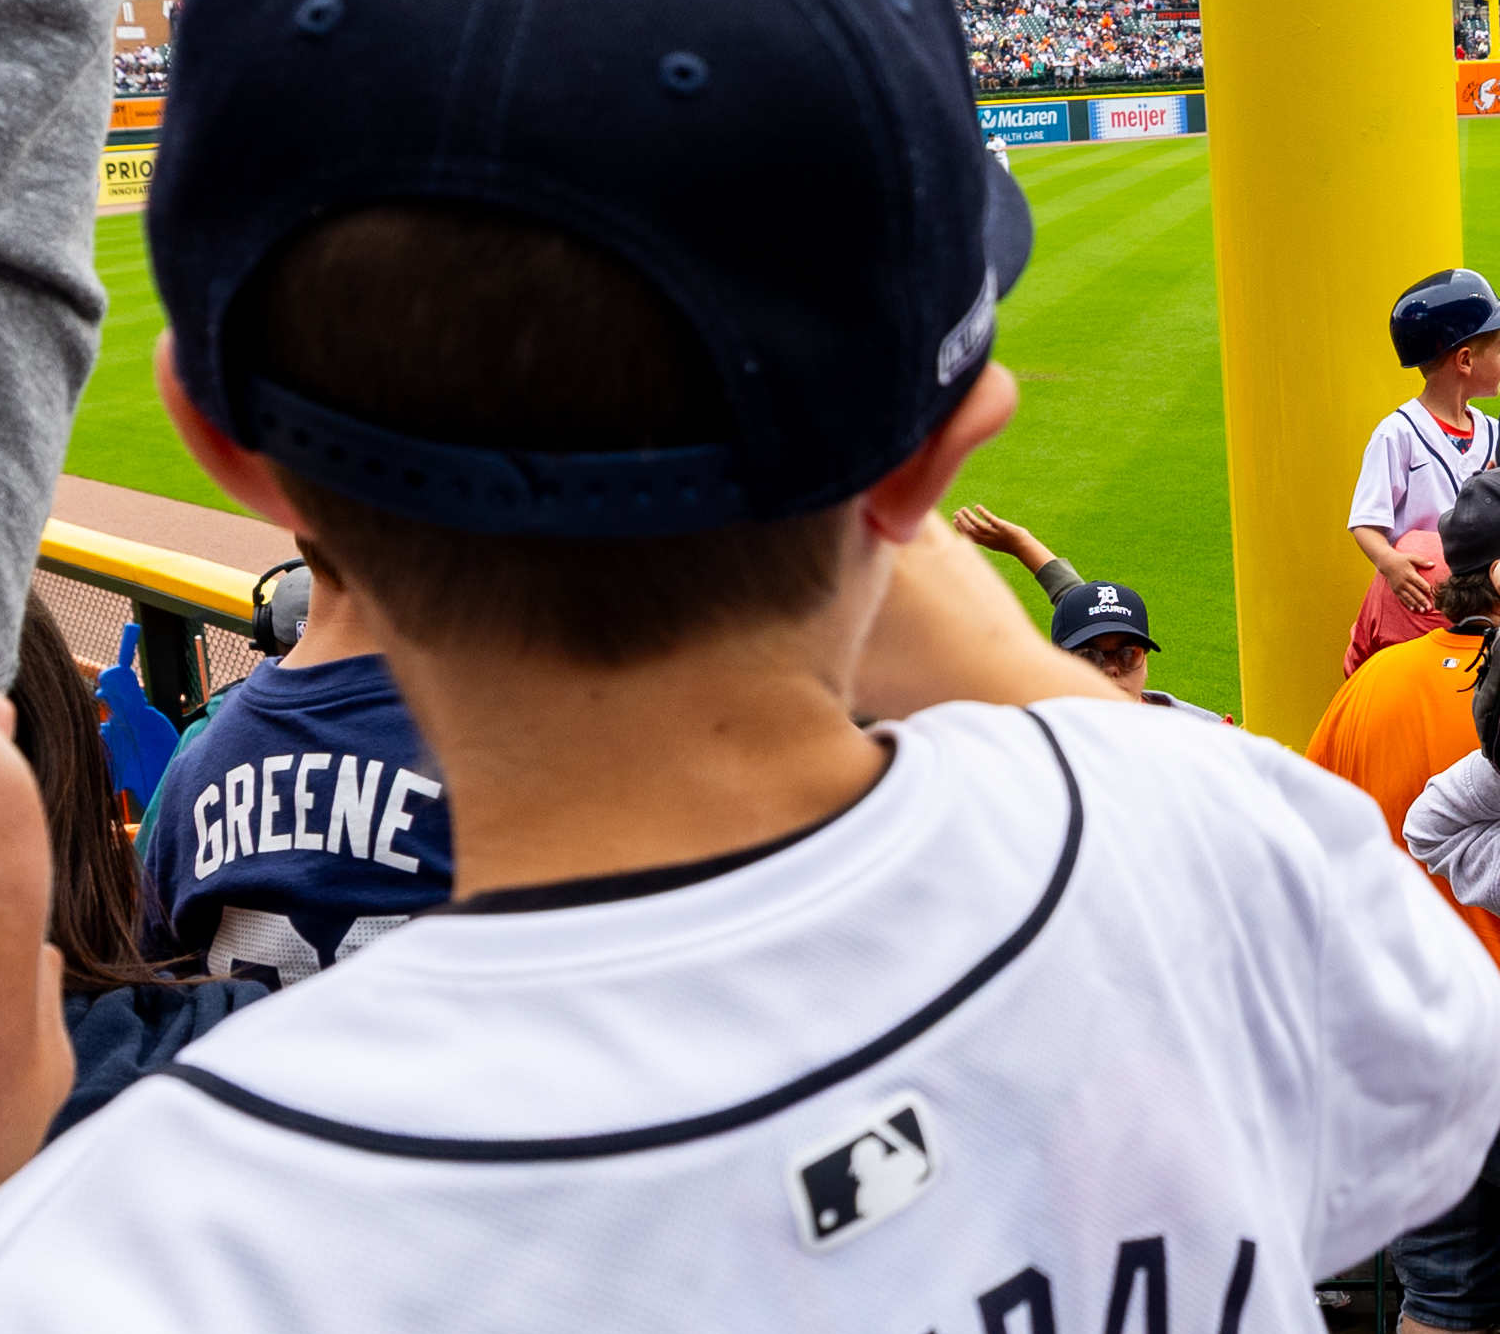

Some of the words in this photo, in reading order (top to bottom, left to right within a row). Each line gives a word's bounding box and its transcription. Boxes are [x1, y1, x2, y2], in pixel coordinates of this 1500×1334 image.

[997, 109, 1057, 128] McLaren
[1111, 103, 1166, 132] meijer
[1024, 130, 1044, 141] CARE
[1088, 604, 1132, 617] SECURITY
[193, 752, 443, 881] GREENE
